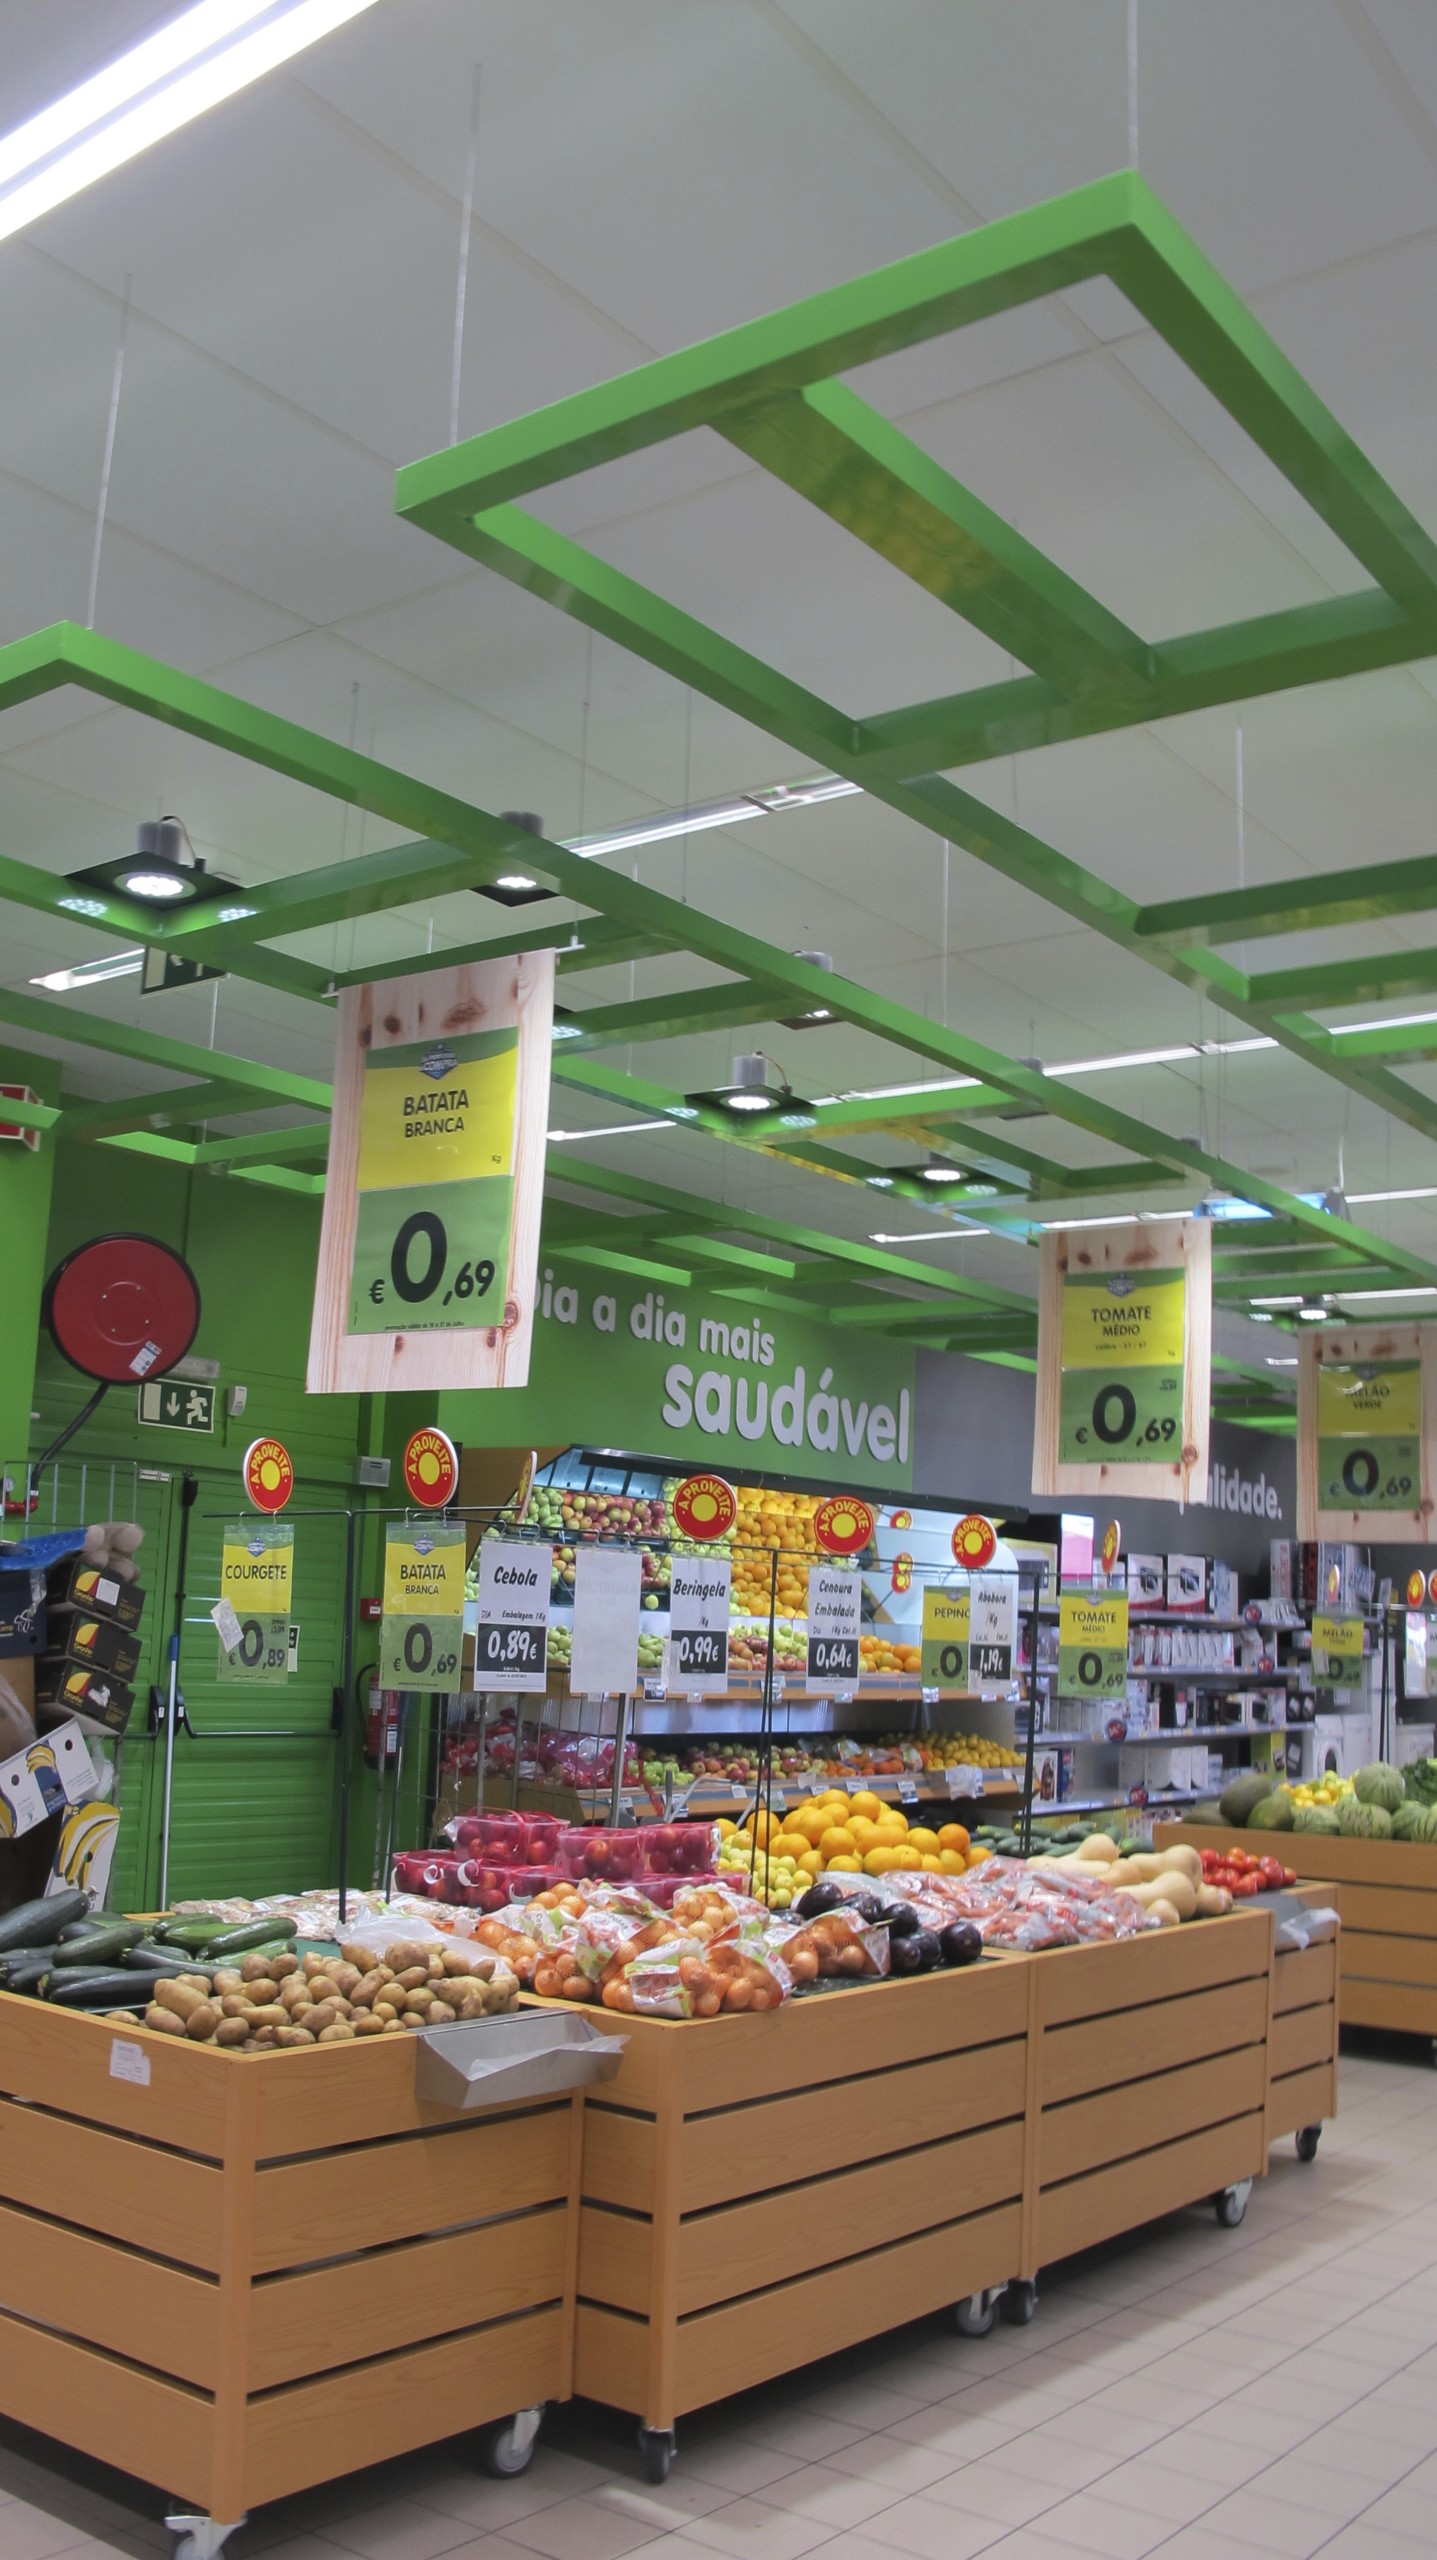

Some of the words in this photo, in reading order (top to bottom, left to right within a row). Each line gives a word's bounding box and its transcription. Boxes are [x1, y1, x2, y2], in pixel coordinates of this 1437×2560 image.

[403, 1089, 469, 1117] BATATA
[405, 1117, 464, 1138] BRANCA
[1091, 1305, 1151, 1323] TOMATE
[592, 1294, 617, 1332] a
[630, 1292, 686, 1348] dia
[700, 1317, 775, 1366] mais
[662, 1363, 910, 1464] saudável
[250, 1443, 291, 1485] APROVEITE
[408, 1435, 452, 1475] APROVEITE
[678, 1479, 732, 1517] APROVEITE
[819, 1500, 870, 1533] APROVEITE
[225, 1564, 288, 1580] COURGETE
[400, 1564, 447, 1580] BATATA
[494, 1565, 538, 1587] Cebola
[405, 1584, 439, 1595] BRANCA
[672, 1578, 727, 1602] Beringela
[819, 1579, 853, 1594] Cenoura
[502, 1610, 534, 1621] Embalagem
[815, 1602, 855, 1618] Embalada
[1071, 1610, 1117, 1624] TOMATE
